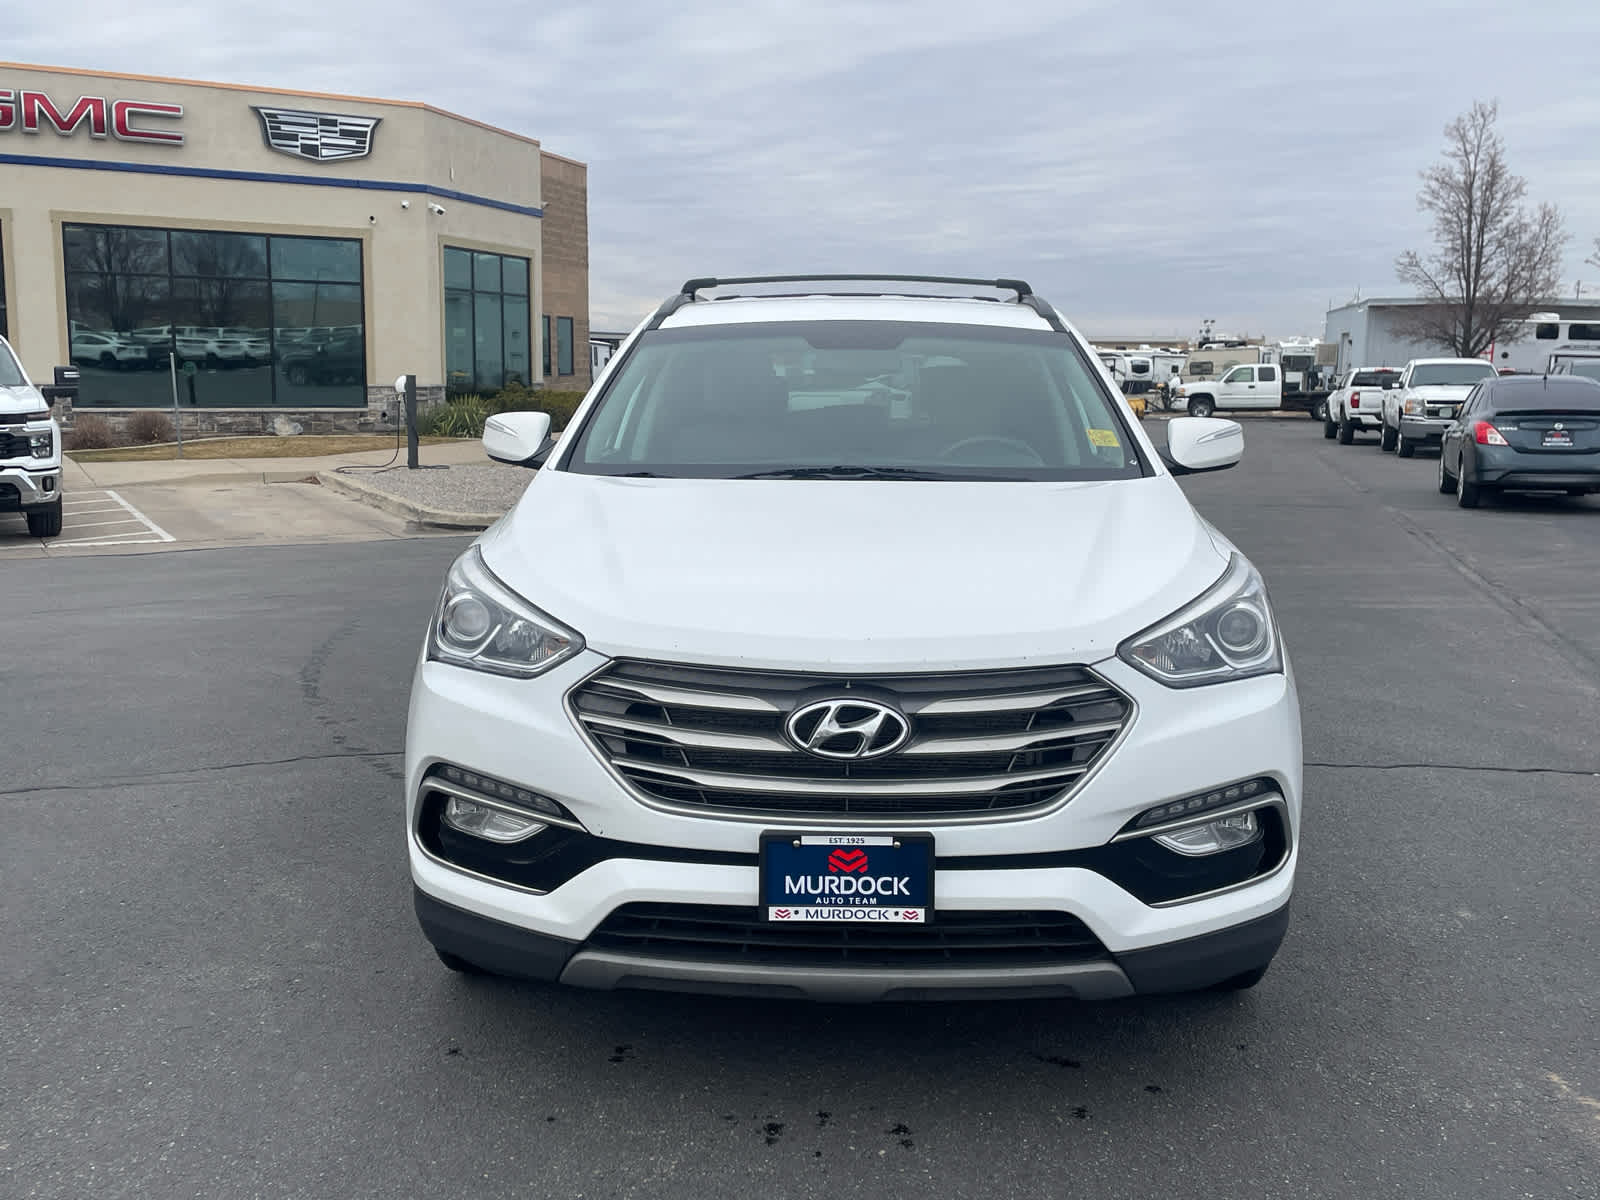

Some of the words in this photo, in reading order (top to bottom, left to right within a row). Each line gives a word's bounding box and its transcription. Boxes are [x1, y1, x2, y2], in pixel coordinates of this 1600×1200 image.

[0, 88, 185, 146] MC
[828, 836, 845, 844] EST.
[784, 875, 911, 896] MURDOCK
[815, 896, 844, 905] AUTO
[849, 897, 877, 905] TEAM
[805, 908, 890, 920] MURDOCK
